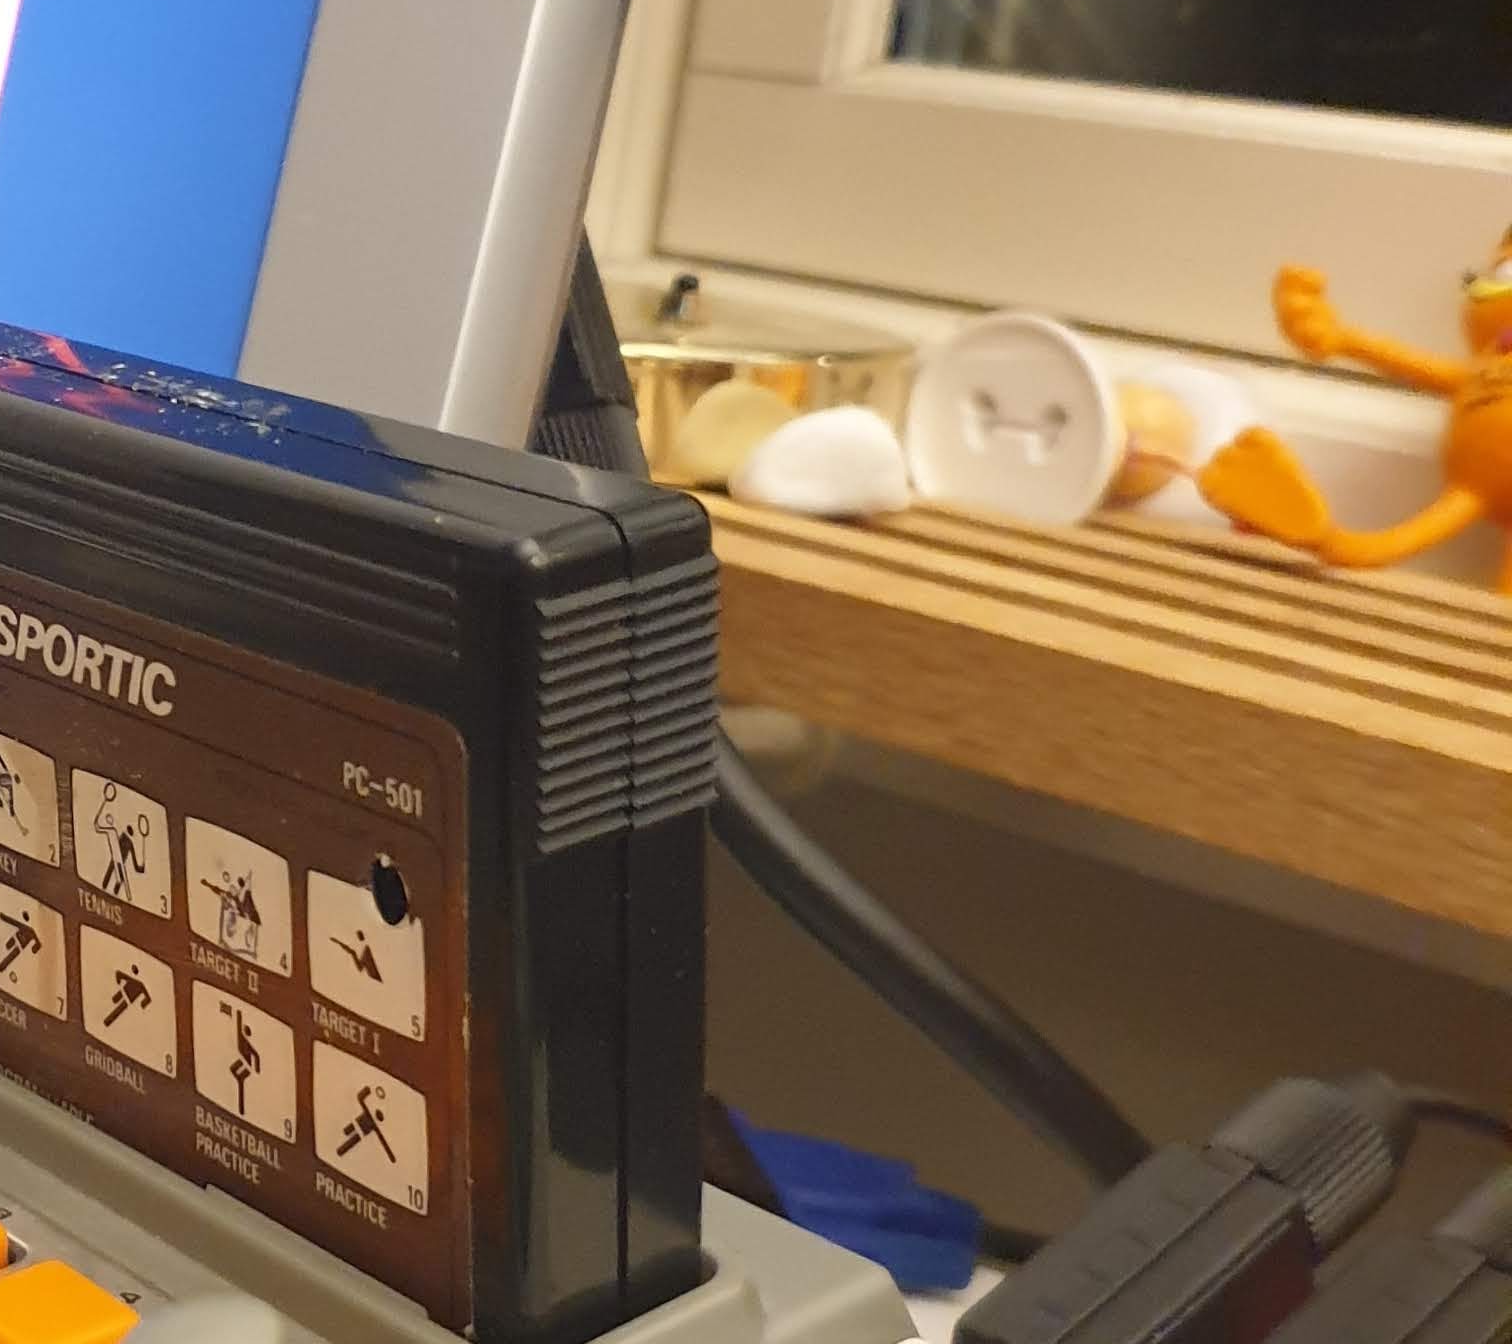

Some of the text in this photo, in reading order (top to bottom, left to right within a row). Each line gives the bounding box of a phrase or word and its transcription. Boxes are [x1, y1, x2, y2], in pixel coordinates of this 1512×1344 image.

[342, 760, 423, 818] PC-501
[47, 843, 56, 863] 2
[77, 887, 124, 926] TENNIS
[159, 894, 168, 914] 3
[189, 942, 239, 984] TARGET
[279, 952, 288, 970] 4
[56, 996, 64, 1015] 7
[311, 1001, 367, 1045] TARGET
[410, 1014, 421, 1038] 5
[84, 1044, 146, 1094] GRIDBALL
[164, 1053, 174, 1074] 8
[195, 1105, 282, 1170] BASKETBALL
[283, 1117, 293, 1139] 9
[195, 1132, 262, 1185] PRACTICE
[316, 1171, 389, 1230] PRACTICE
[407, 1184, 424, 1211] 10
[119, 1291, 142, 1305] 4
